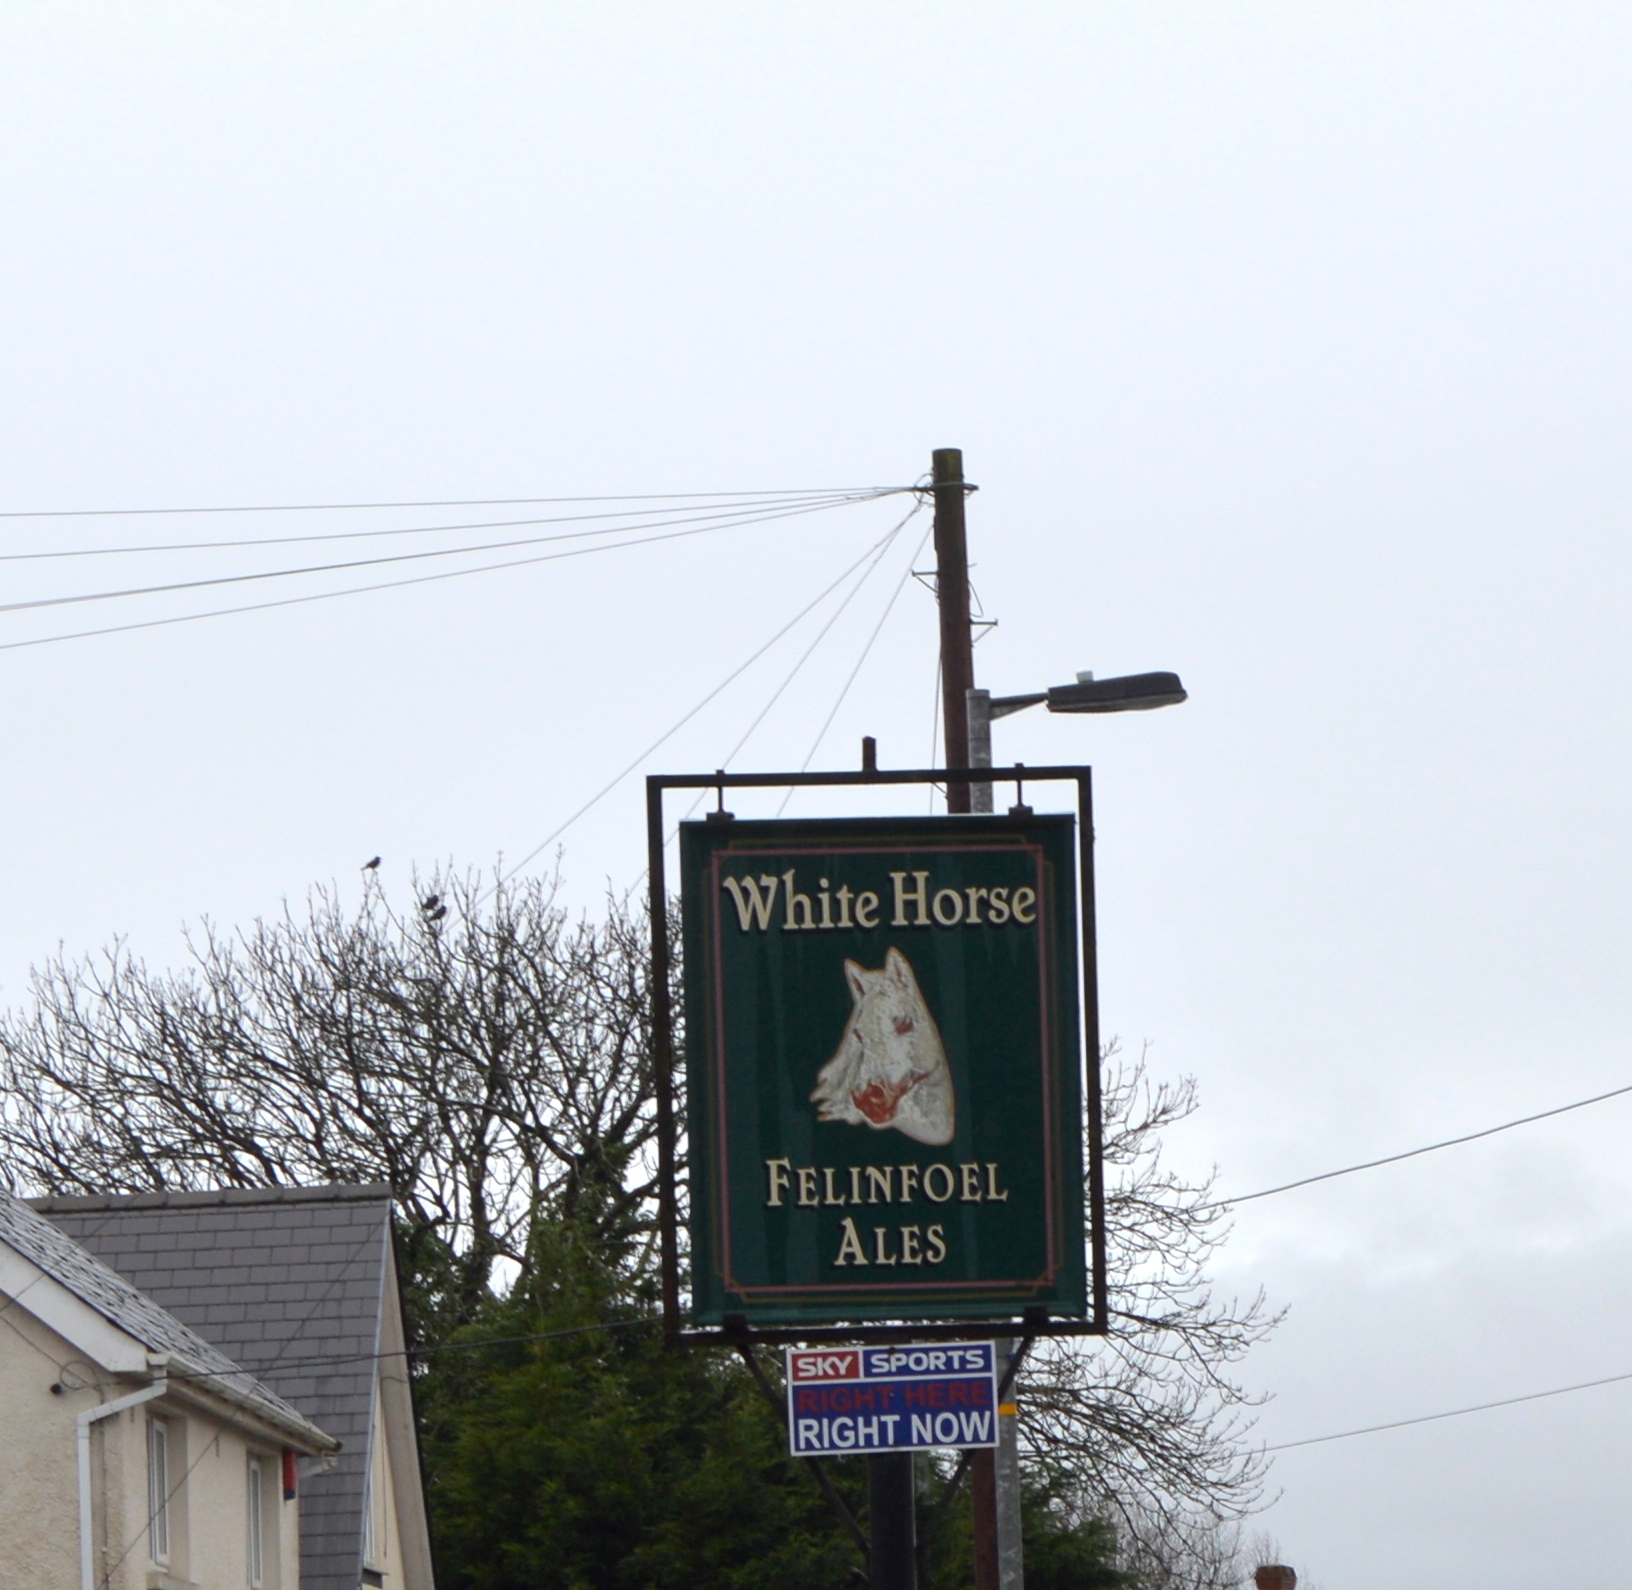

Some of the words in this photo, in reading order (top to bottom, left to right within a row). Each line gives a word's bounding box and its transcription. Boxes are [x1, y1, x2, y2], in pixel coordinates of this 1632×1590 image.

[722, 868, 880, 932] White
[889, 870, 1036, 927] Horse
[797, 1356, 853, 1377] SKY
[870, 1350, 985, 1374] SPORTS
[797, 1386, 895, 1414] RIGHT
[904, 1381, 989, 1409] HERE
[798, 1415, 901, 1450] RIGHT
[911, 1410, 992, 1445] NOW
